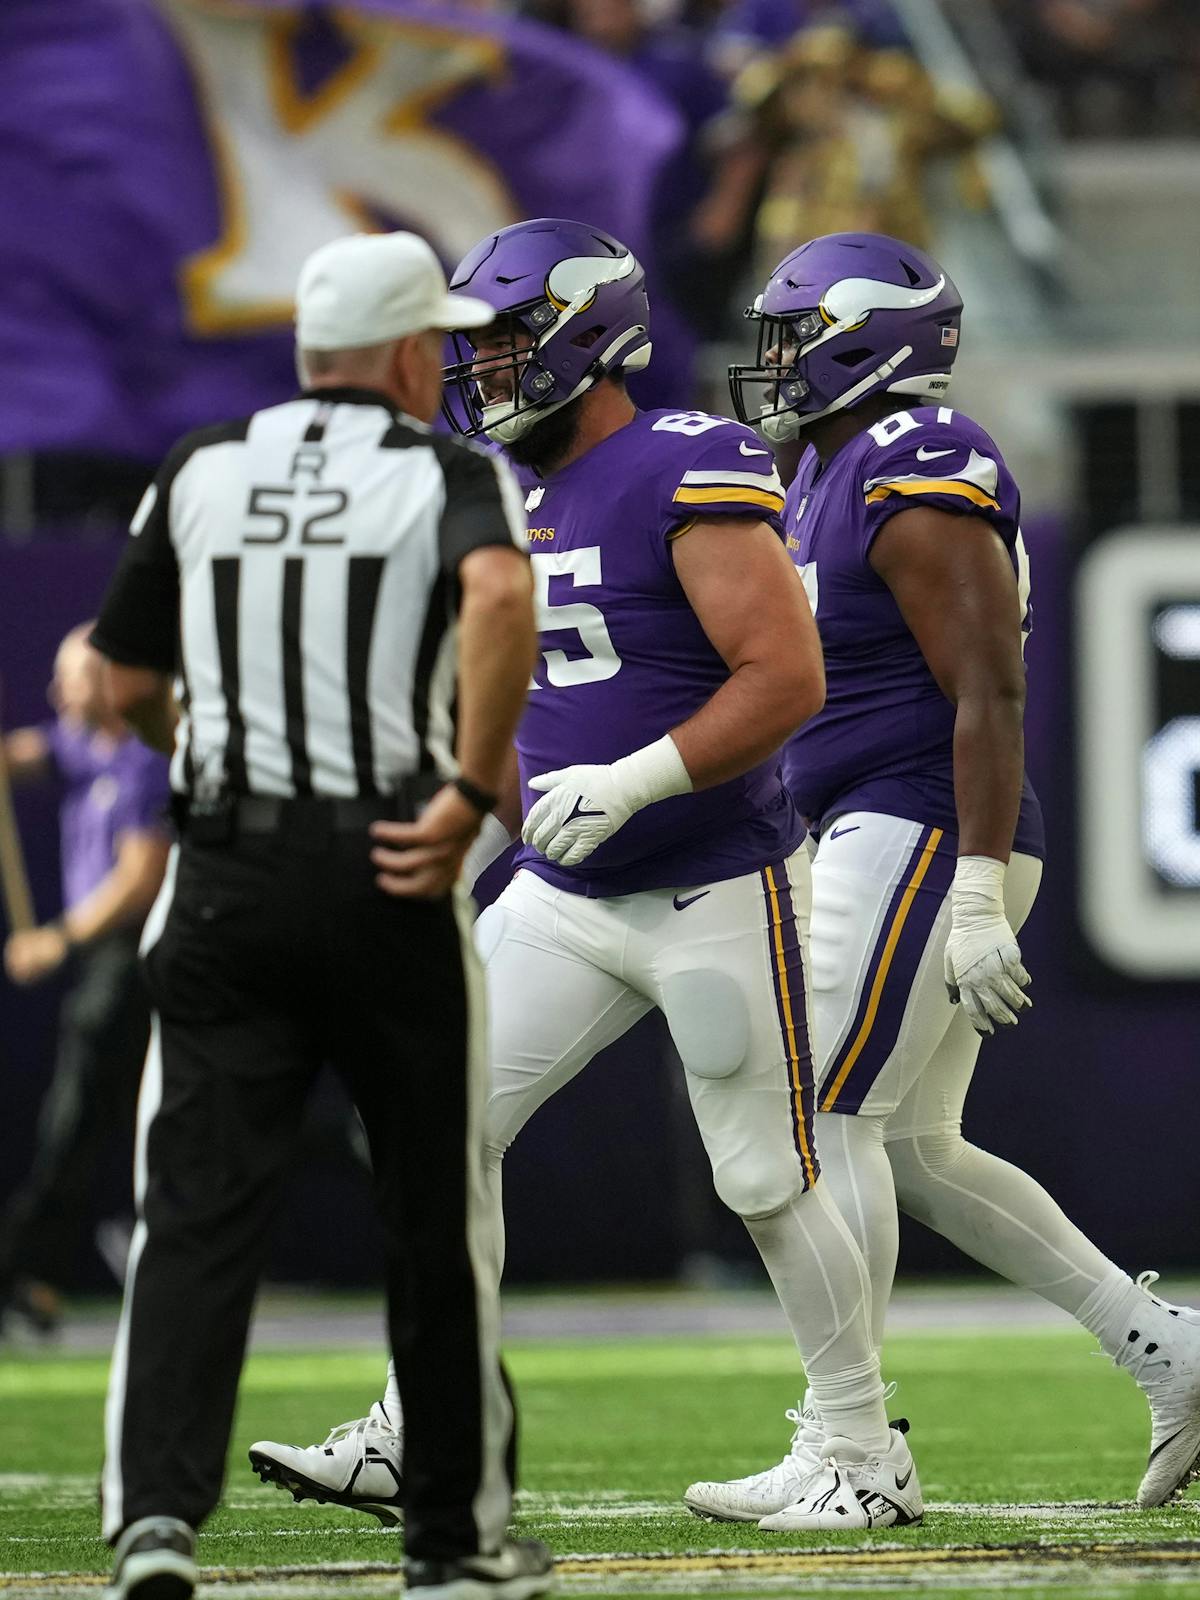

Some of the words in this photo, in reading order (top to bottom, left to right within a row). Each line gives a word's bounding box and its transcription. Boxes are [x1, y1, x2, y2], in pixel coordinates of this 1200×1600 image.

[168, 4, 524, 338] K
[243, 488, 348, 545] 52
[289, 450, 328, 483] R
[528, 546, 622, 690] 5
